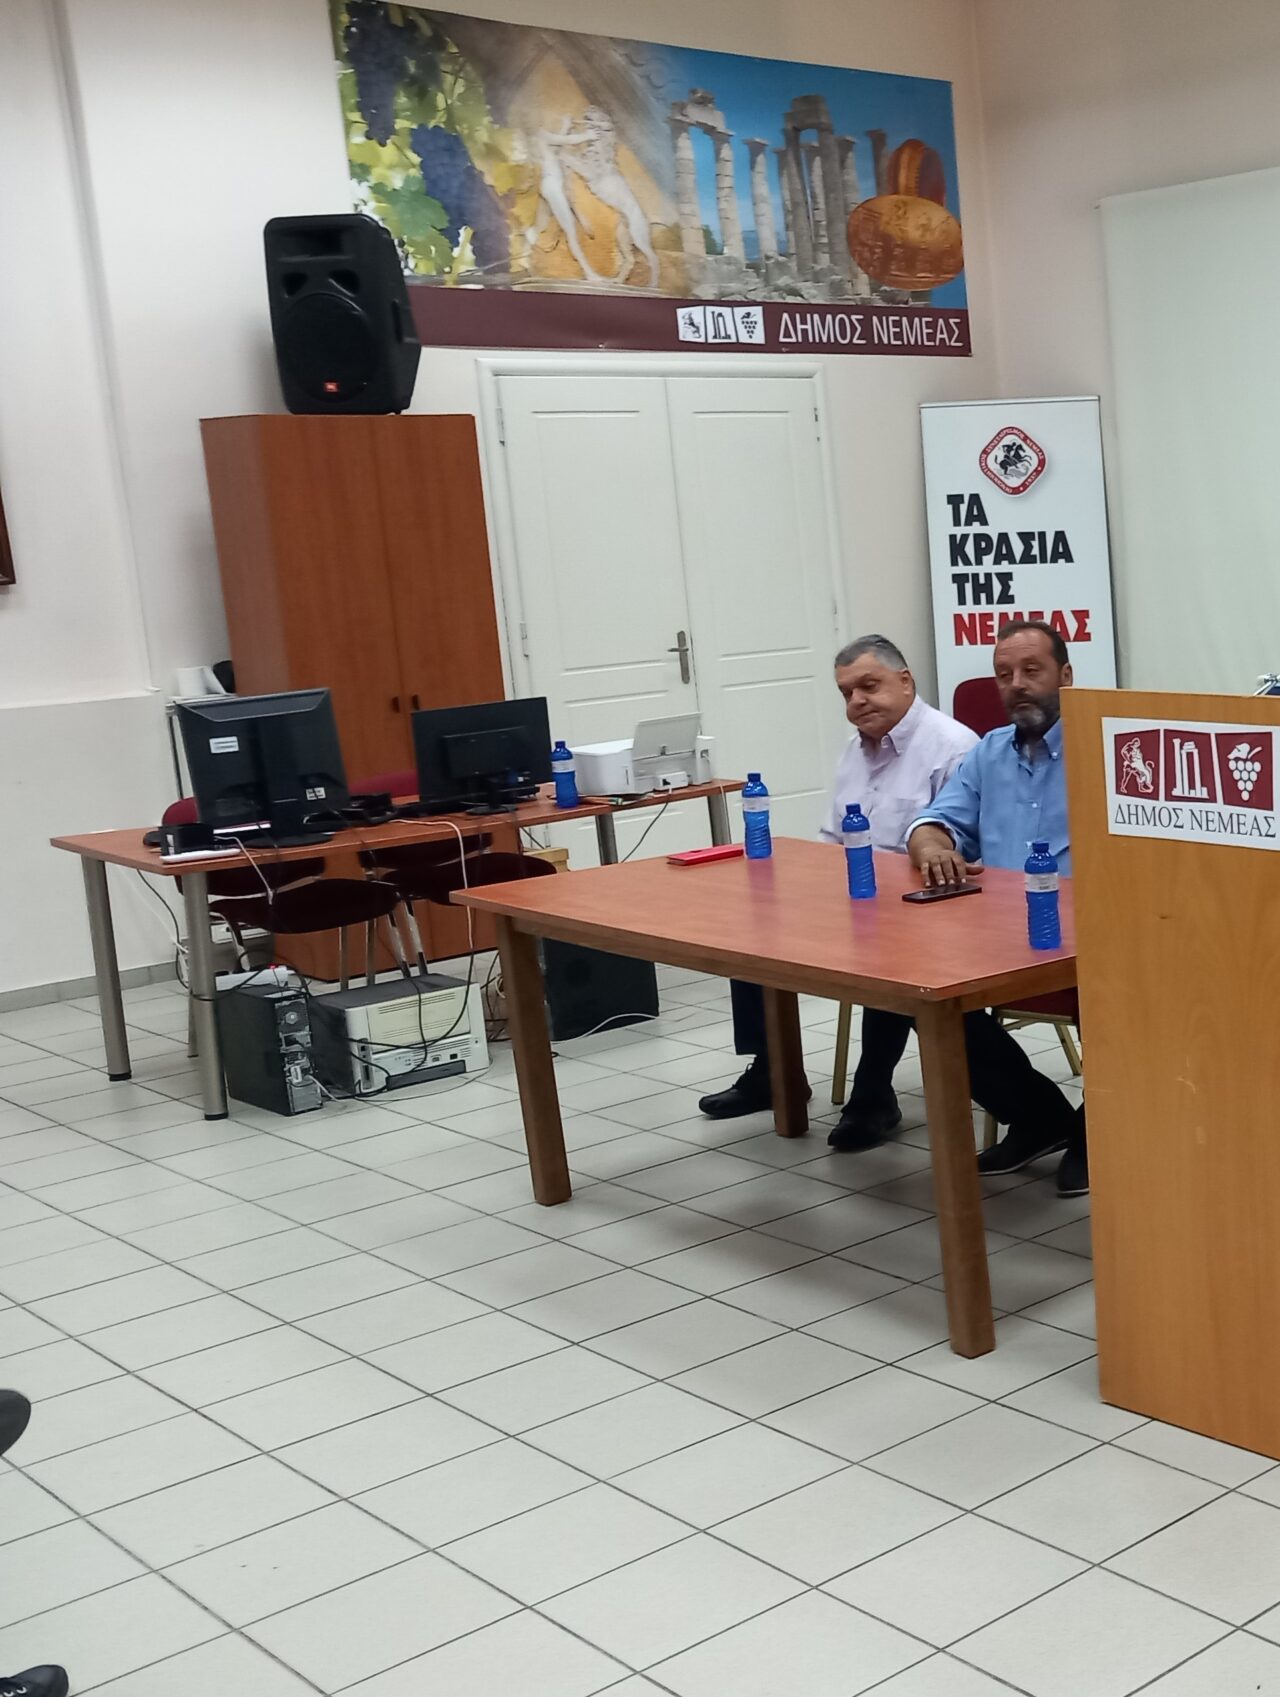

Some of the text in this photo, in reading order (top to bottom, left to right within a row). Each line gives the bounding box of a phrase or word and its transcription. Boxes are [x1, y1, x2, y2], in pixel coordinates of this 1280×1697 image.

[778, 311, 964, 347] ΔΗΜΟΣ ΝΕΜΕΑΣ
[946, 493, 990, 528] ΤΑ
[948, 530, 1075, 567] ΚΡΑΣΙΑ
[951, 571, 1016, 606] ΤΗΣ
[953, 609, 1092, 646] ΝΕΑΣ
[1114, 803, 1277, 839] ΔΗΜΟΣ ΝΕΜΕΑΣ
